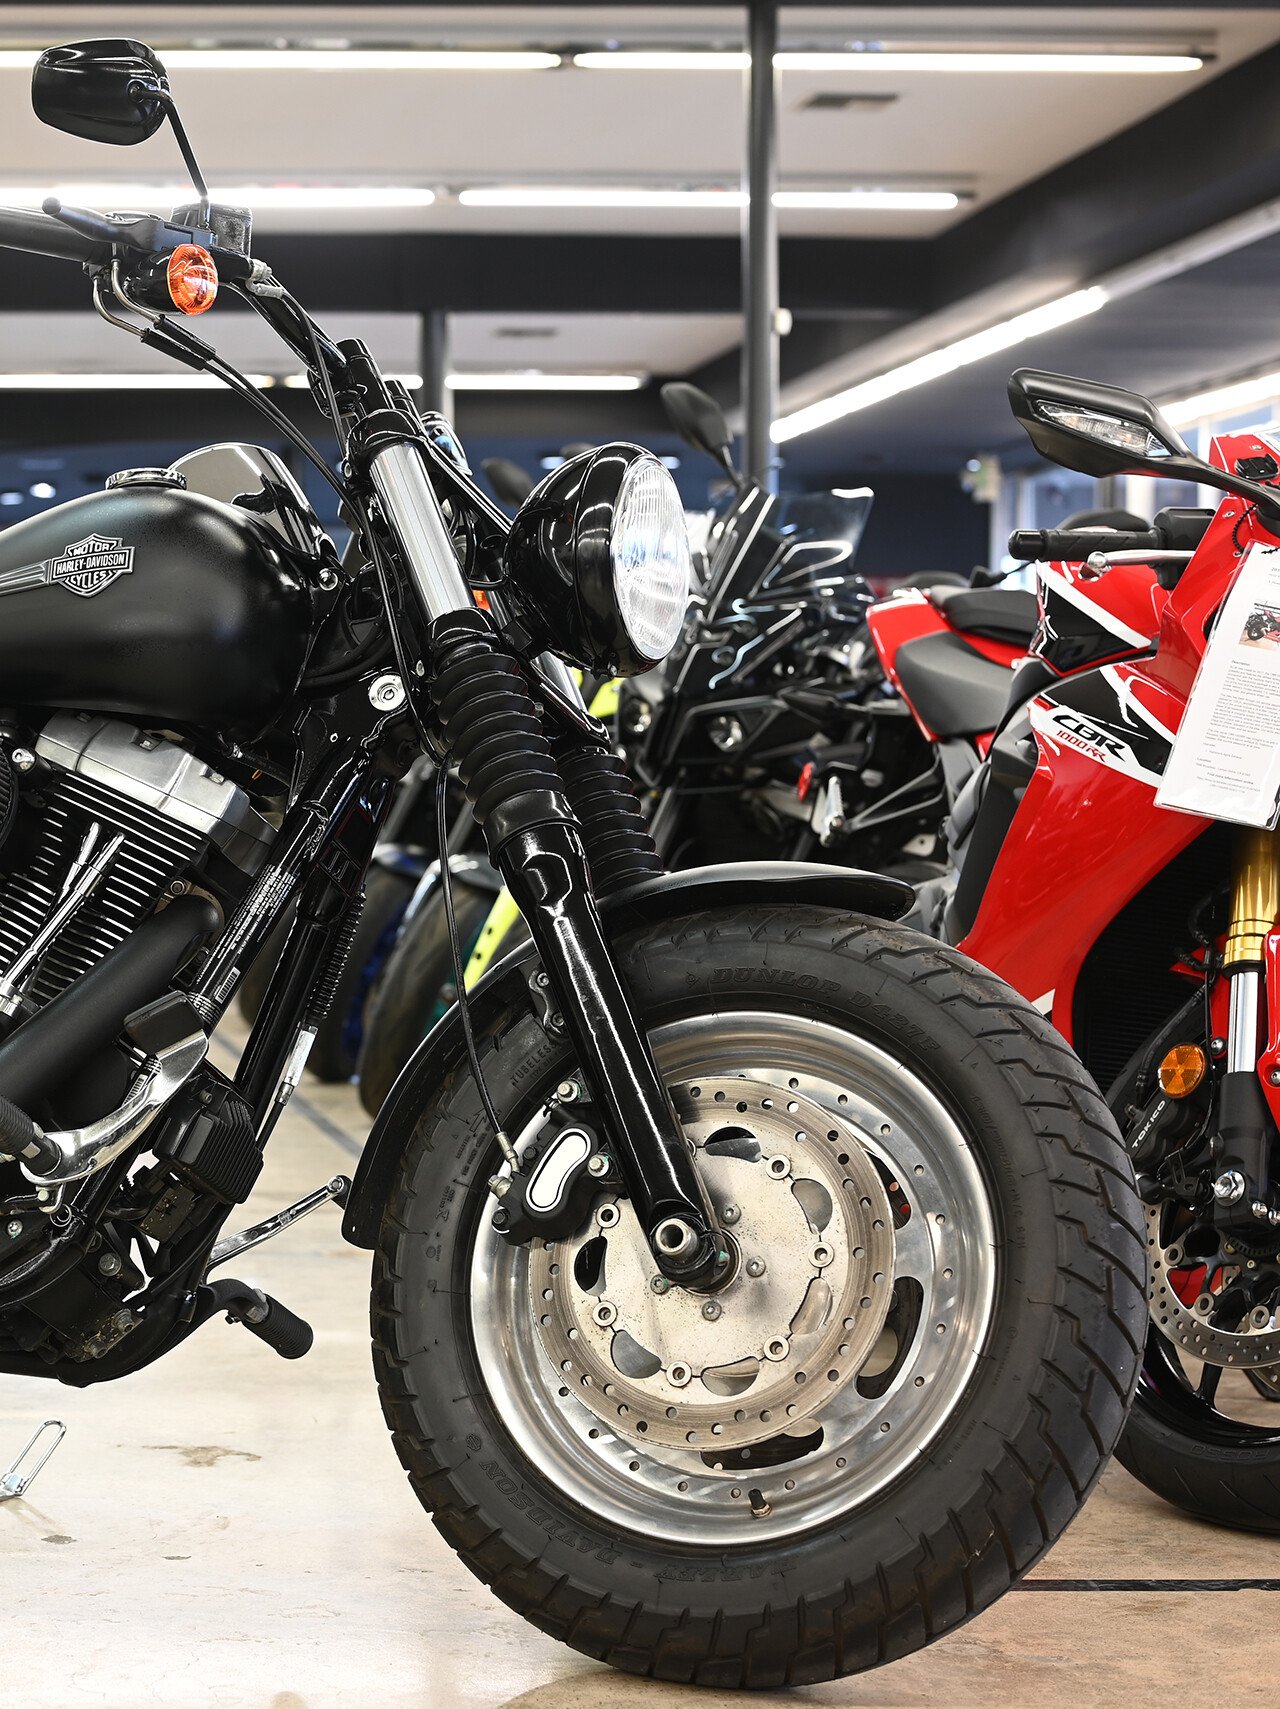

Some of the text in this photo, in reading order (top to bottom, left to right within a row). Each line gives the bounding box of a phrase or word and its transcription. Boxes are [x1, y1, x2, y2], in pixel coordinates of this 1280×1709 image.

[57, 553, 125, 575] HARLEY-DAVIDSON
[73, 541, 110, 556] MOTOR
[70, 570, 107, 588] CYCLES
[1053, 715, 1125, 762] CBR
[1057, 730, 1106, 763] 1000RR
[711, 967, 941, 1050] DUNLOP D427F
[1132, 1100, 1166, 1148] TOKICO
